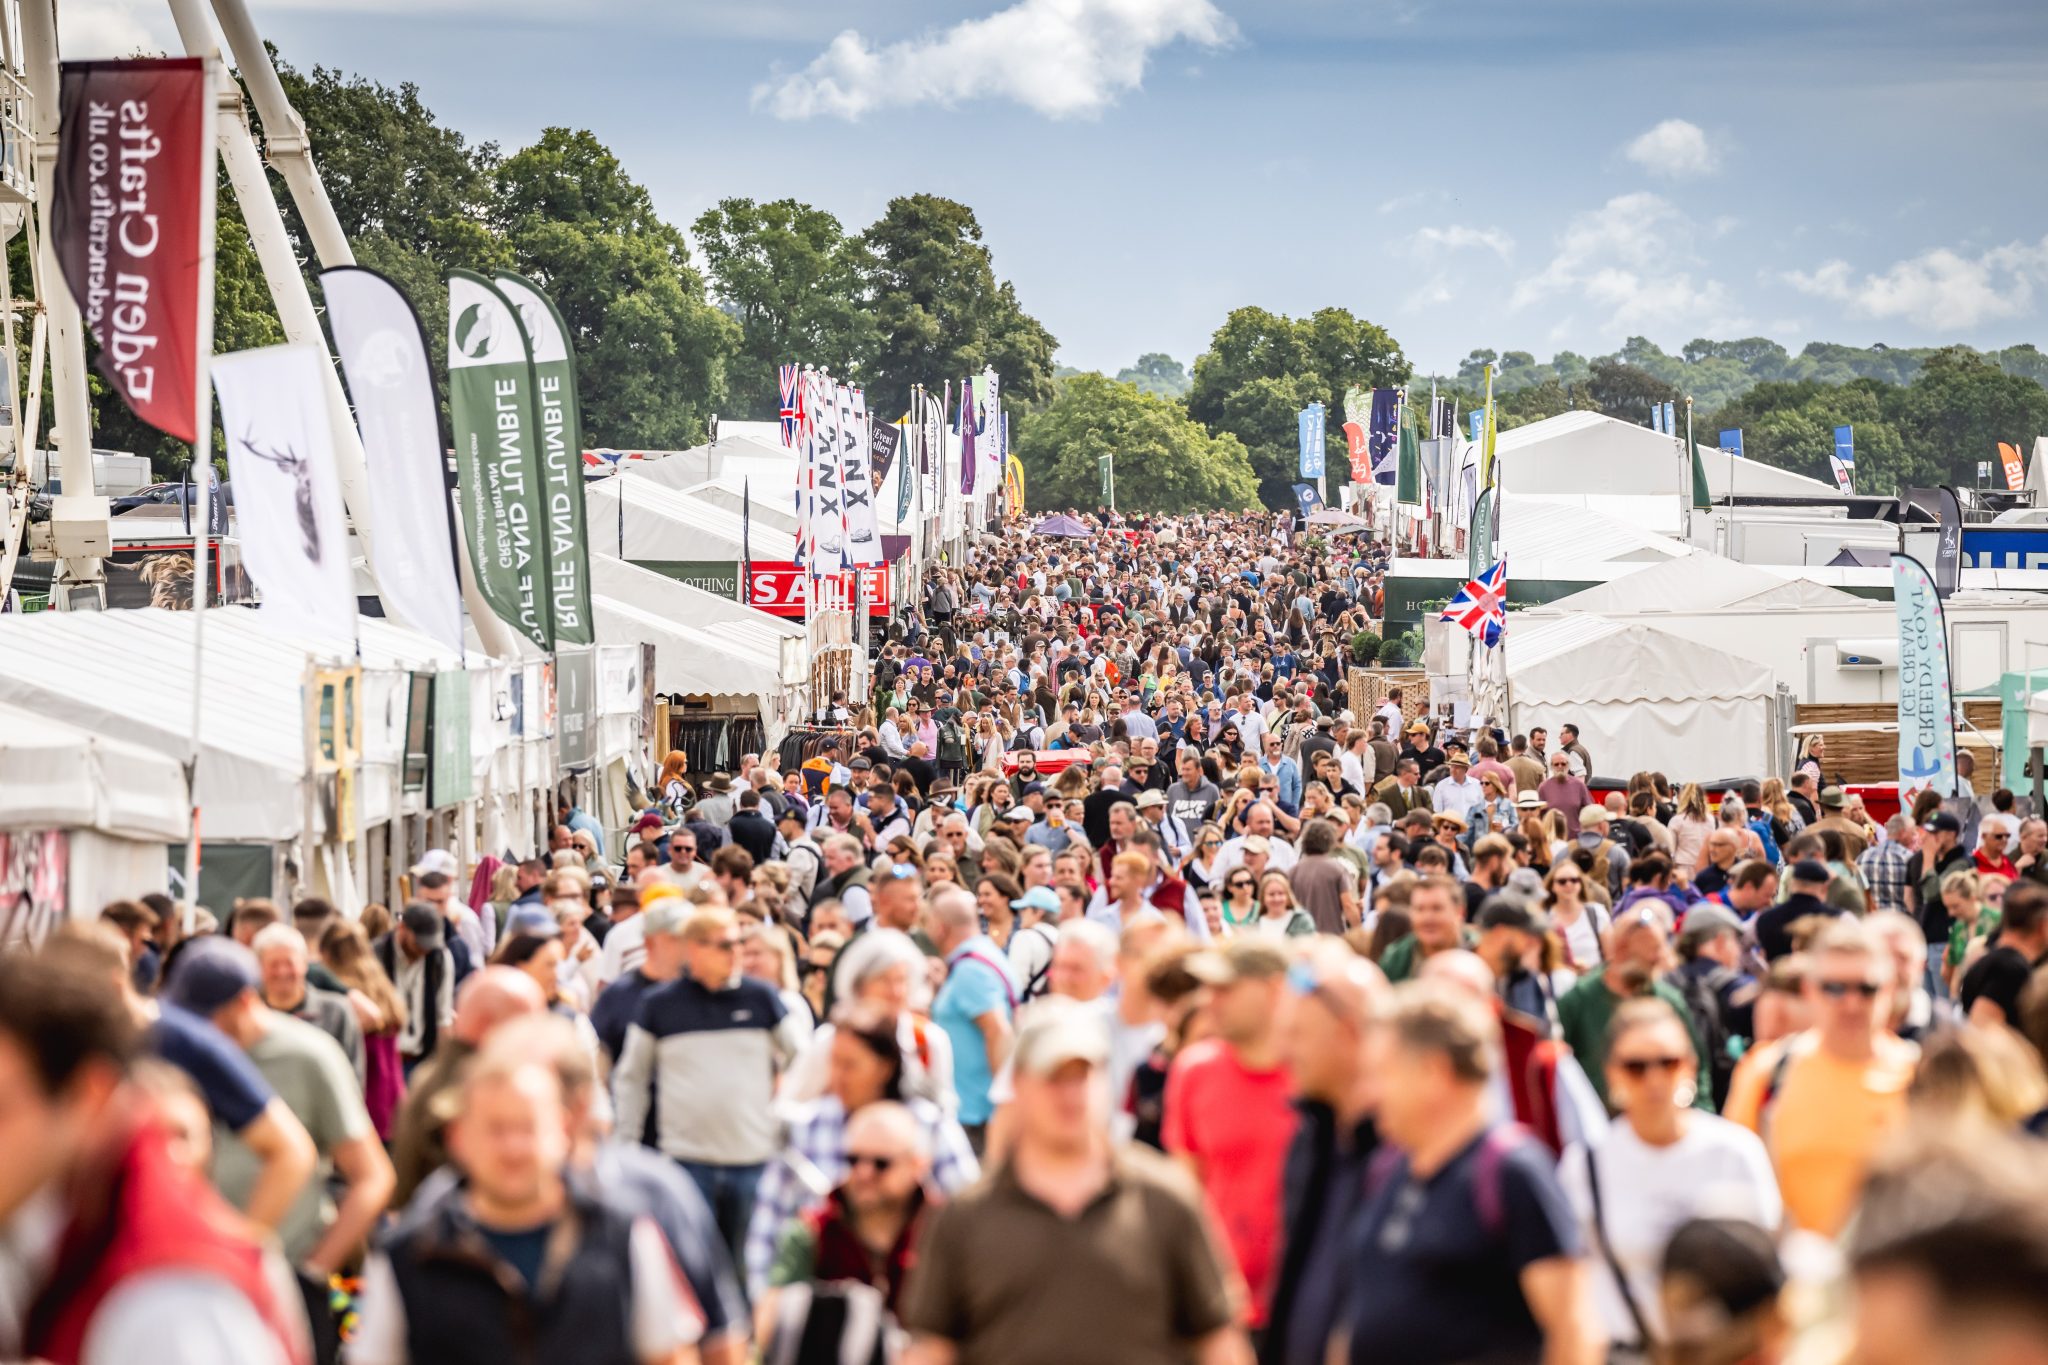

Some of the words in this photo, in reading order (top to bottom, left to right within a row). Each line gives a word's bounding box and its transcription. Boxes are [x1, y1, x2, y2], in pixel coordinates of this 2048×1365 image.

[814, 406, 839, 517] LANX
[841, 407, 869, 509] LANX
[872, 439, 891, 458] allery
[1174, 799, 1208, 819] NIKE
